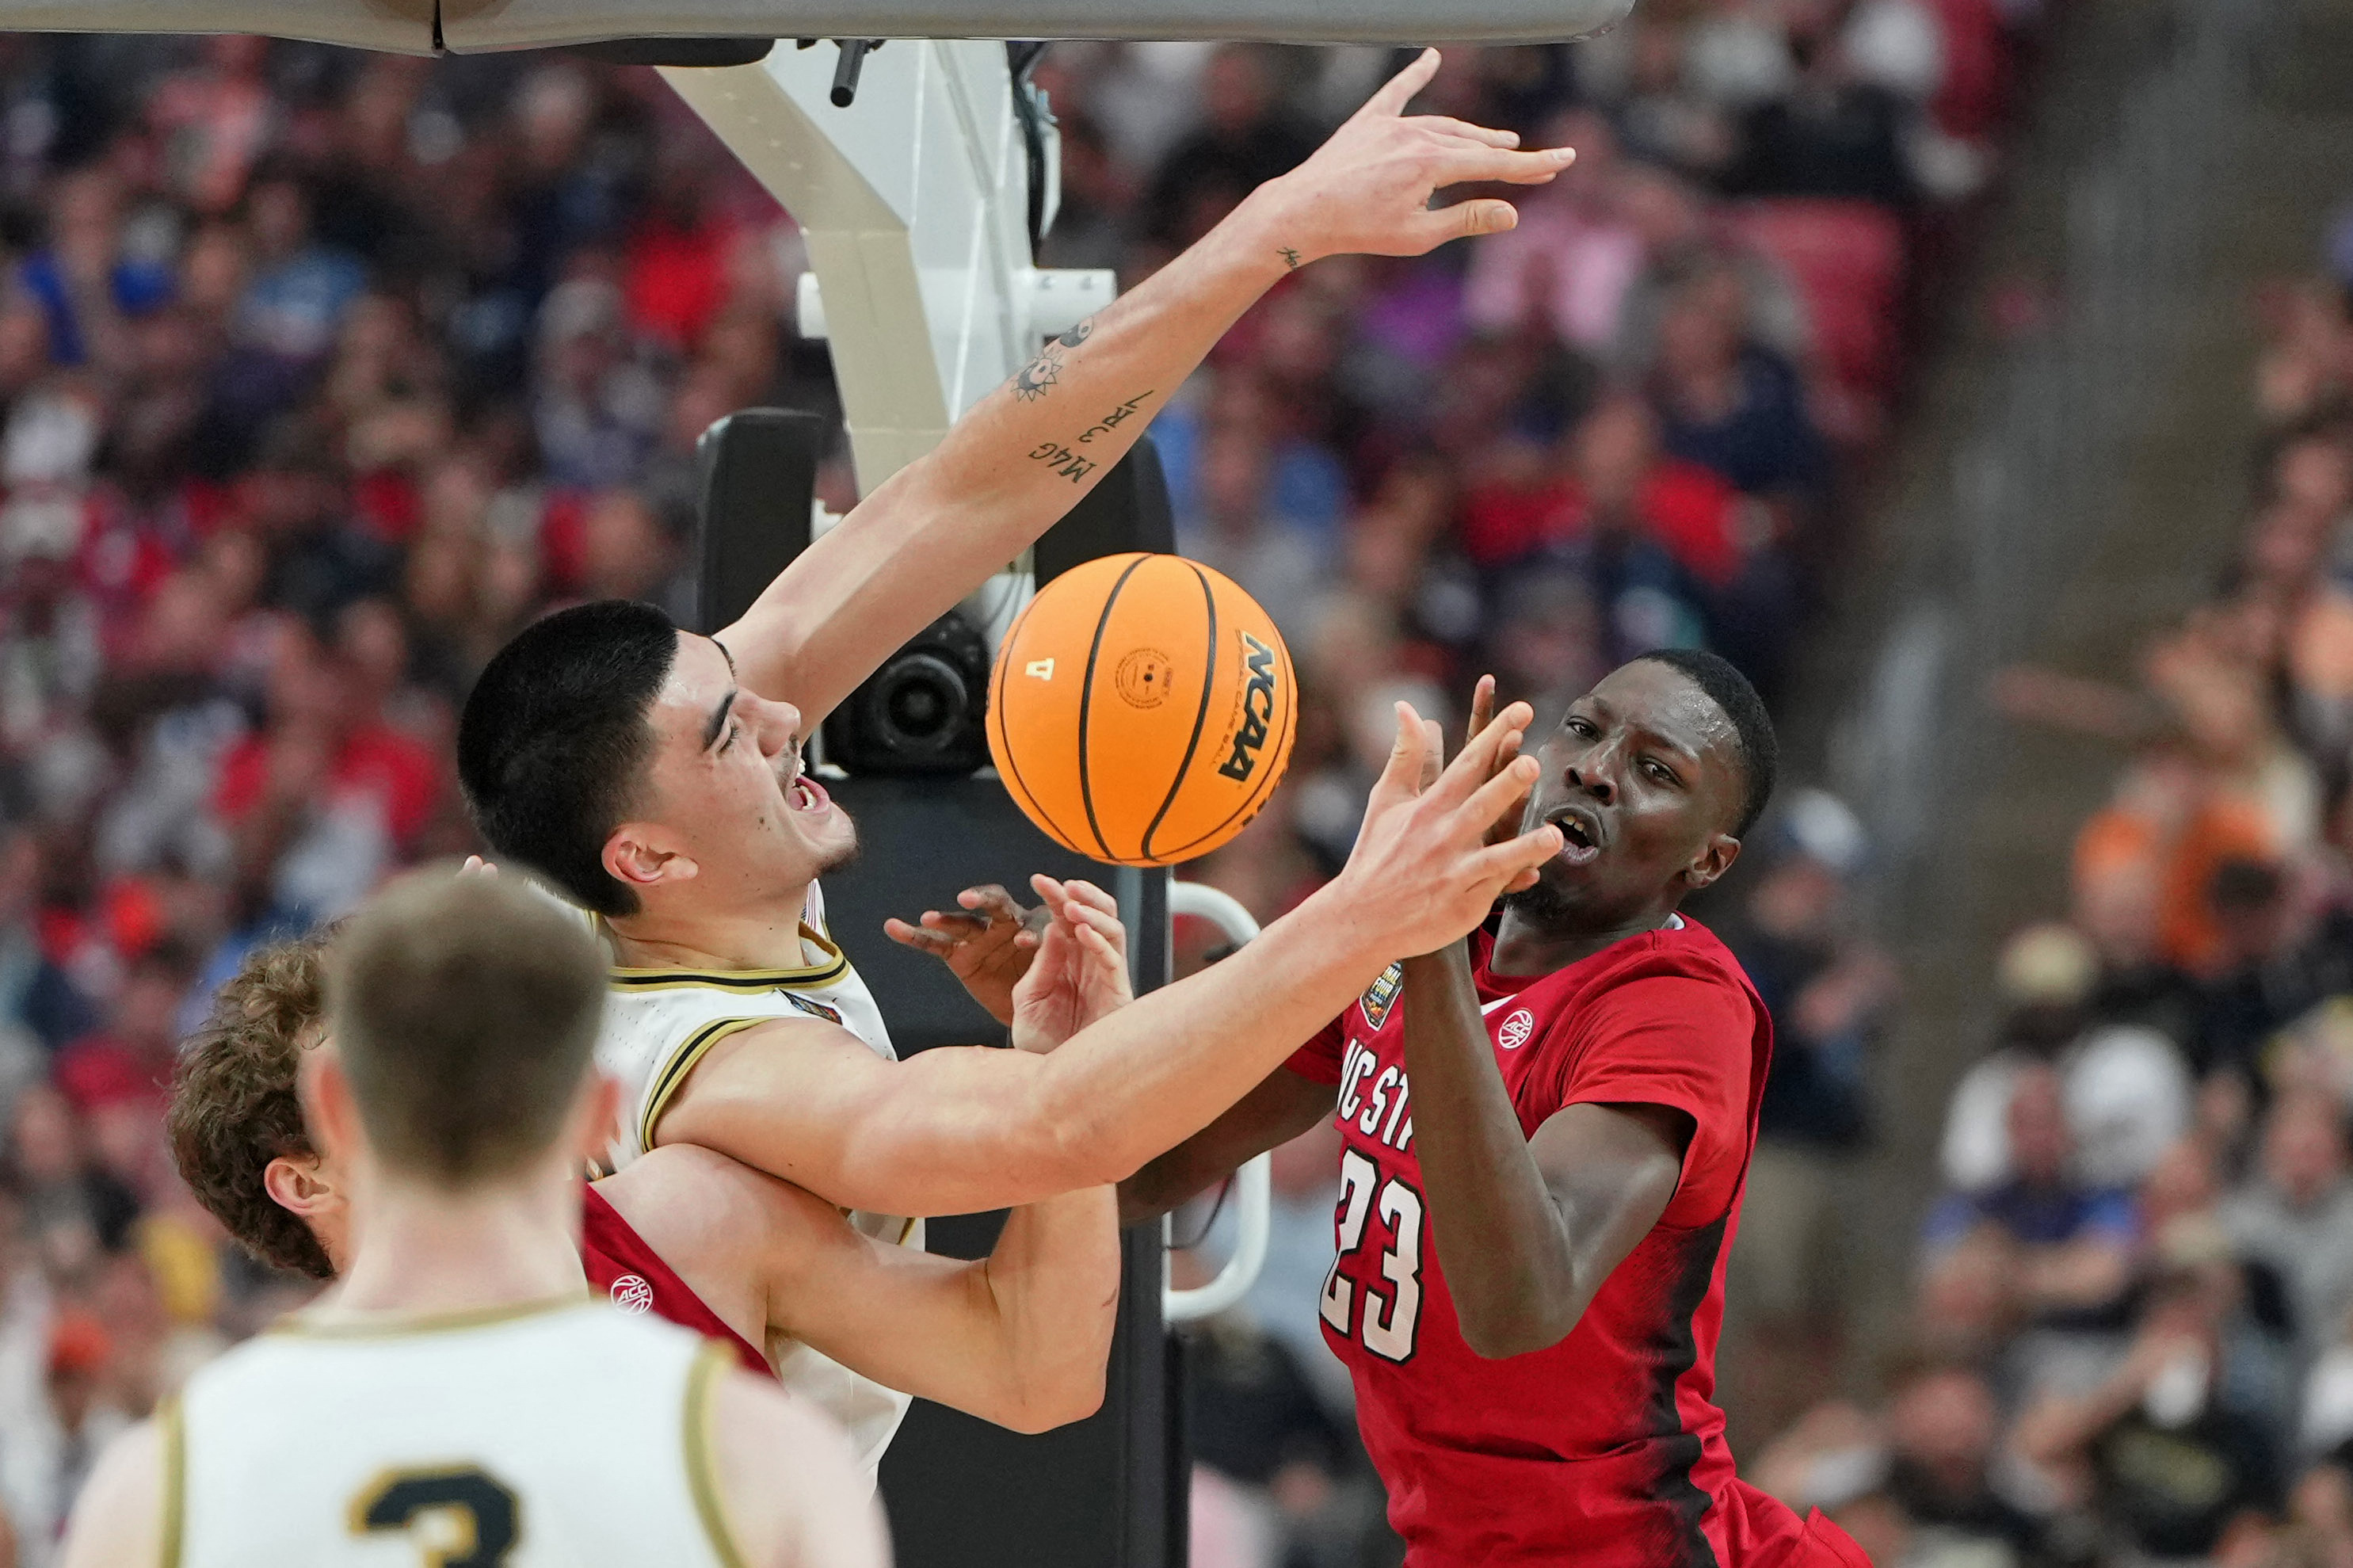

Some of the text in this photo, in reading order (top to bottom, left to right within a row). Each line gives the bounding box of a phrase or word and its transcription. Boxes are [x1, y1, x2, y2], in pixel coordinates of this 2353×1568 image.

[1028, 443, 1097, 483] M4G
[1218, 630, 1276, 782] NCAA
[1381, 965, 1402, 986] INAL
[1336, 1036, 1379, 1122] NC
[1318, 1143, 1424, 1366] 23
